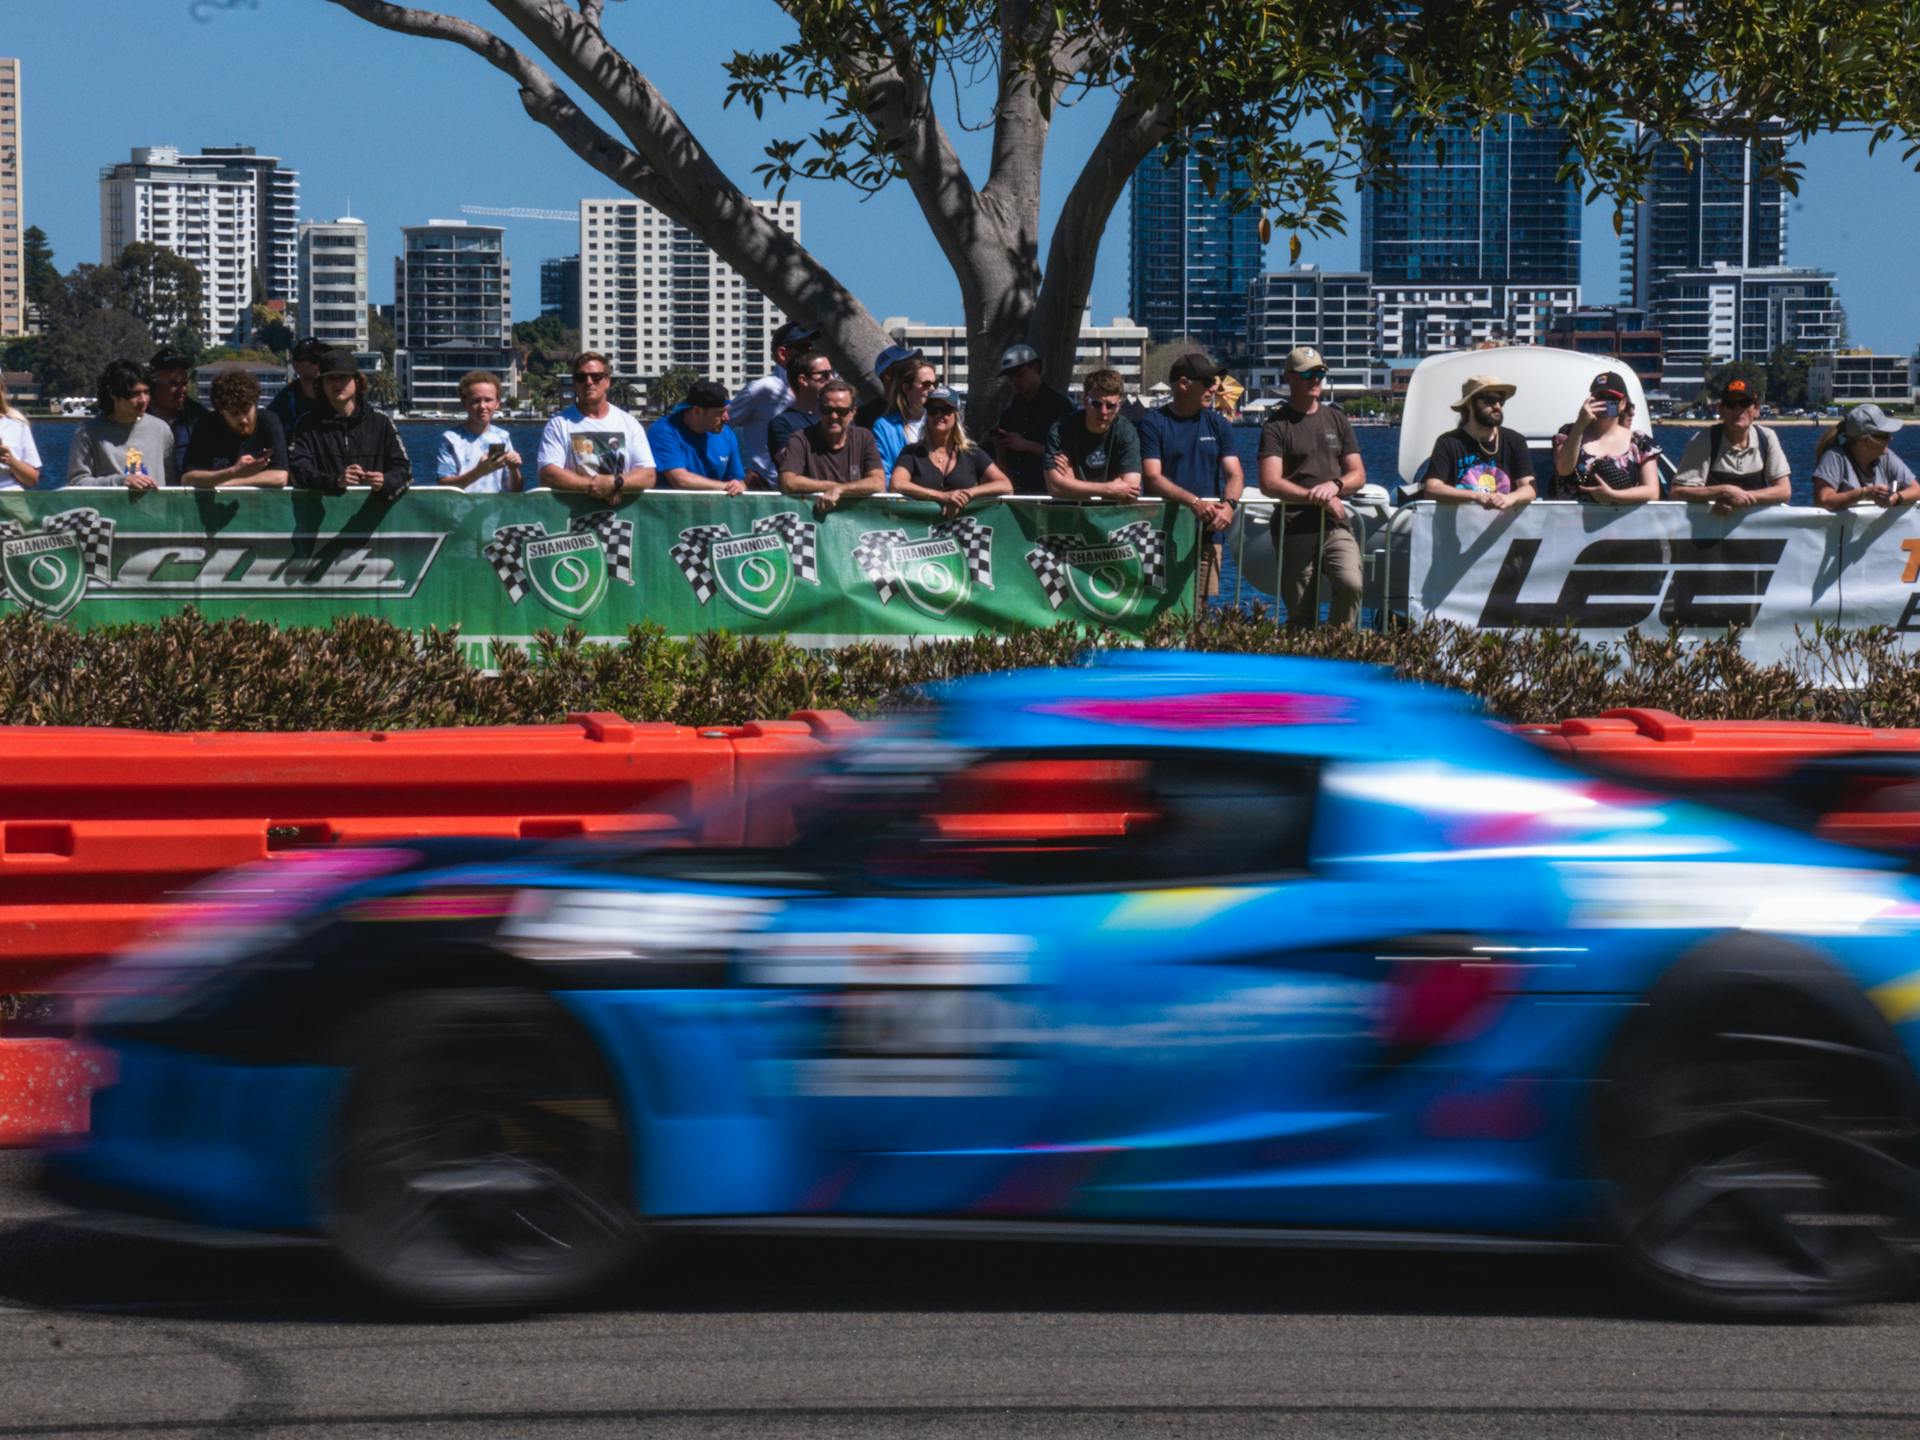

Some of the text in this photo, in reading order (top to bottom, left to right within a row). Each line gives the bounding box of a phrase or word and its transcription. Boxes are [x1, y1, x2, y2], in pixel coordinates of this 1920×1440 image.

[6, 534, 74, 556] SHANNONS
[529, 535, 594, 558] SHANNONS
[715, 534, 780, 559] SHANNONS
[895, 541, 956, 562] SHANNONS
[1069, 545, 1133, 566] SHANNONS
[115, 546, 405, 588] Club
[1477, 538, 1789, 628] LEE
